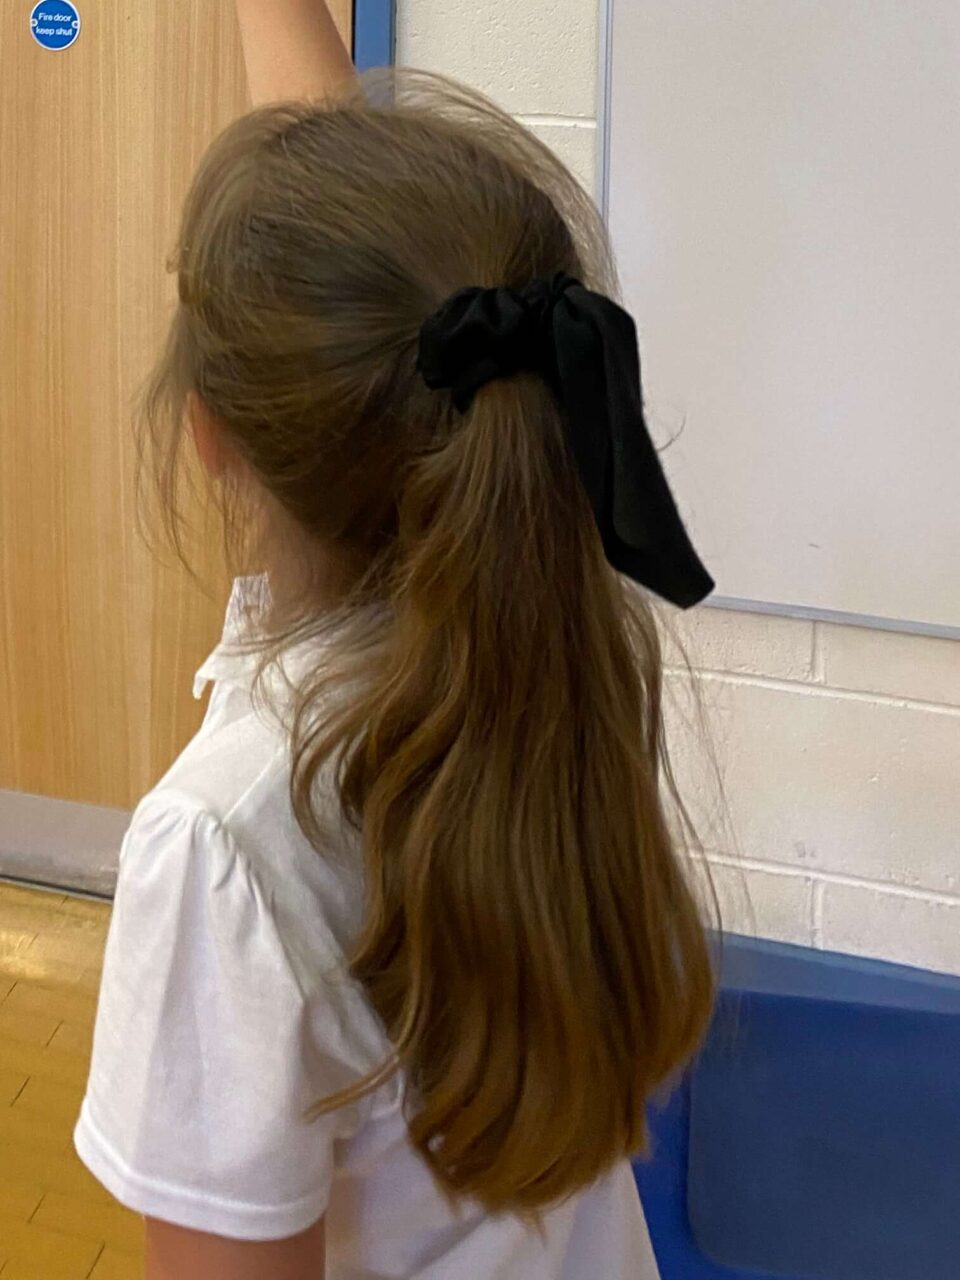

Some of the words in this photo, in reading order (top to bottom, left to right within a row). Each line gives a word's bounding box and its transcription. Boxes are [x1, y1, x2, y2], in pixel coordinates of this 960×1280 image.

[38, 12, 53, 21] Fire
[53, 12, 72, 22] door
[36, 26, 55, 37] keep
[55, 27, 73, 36] shut
